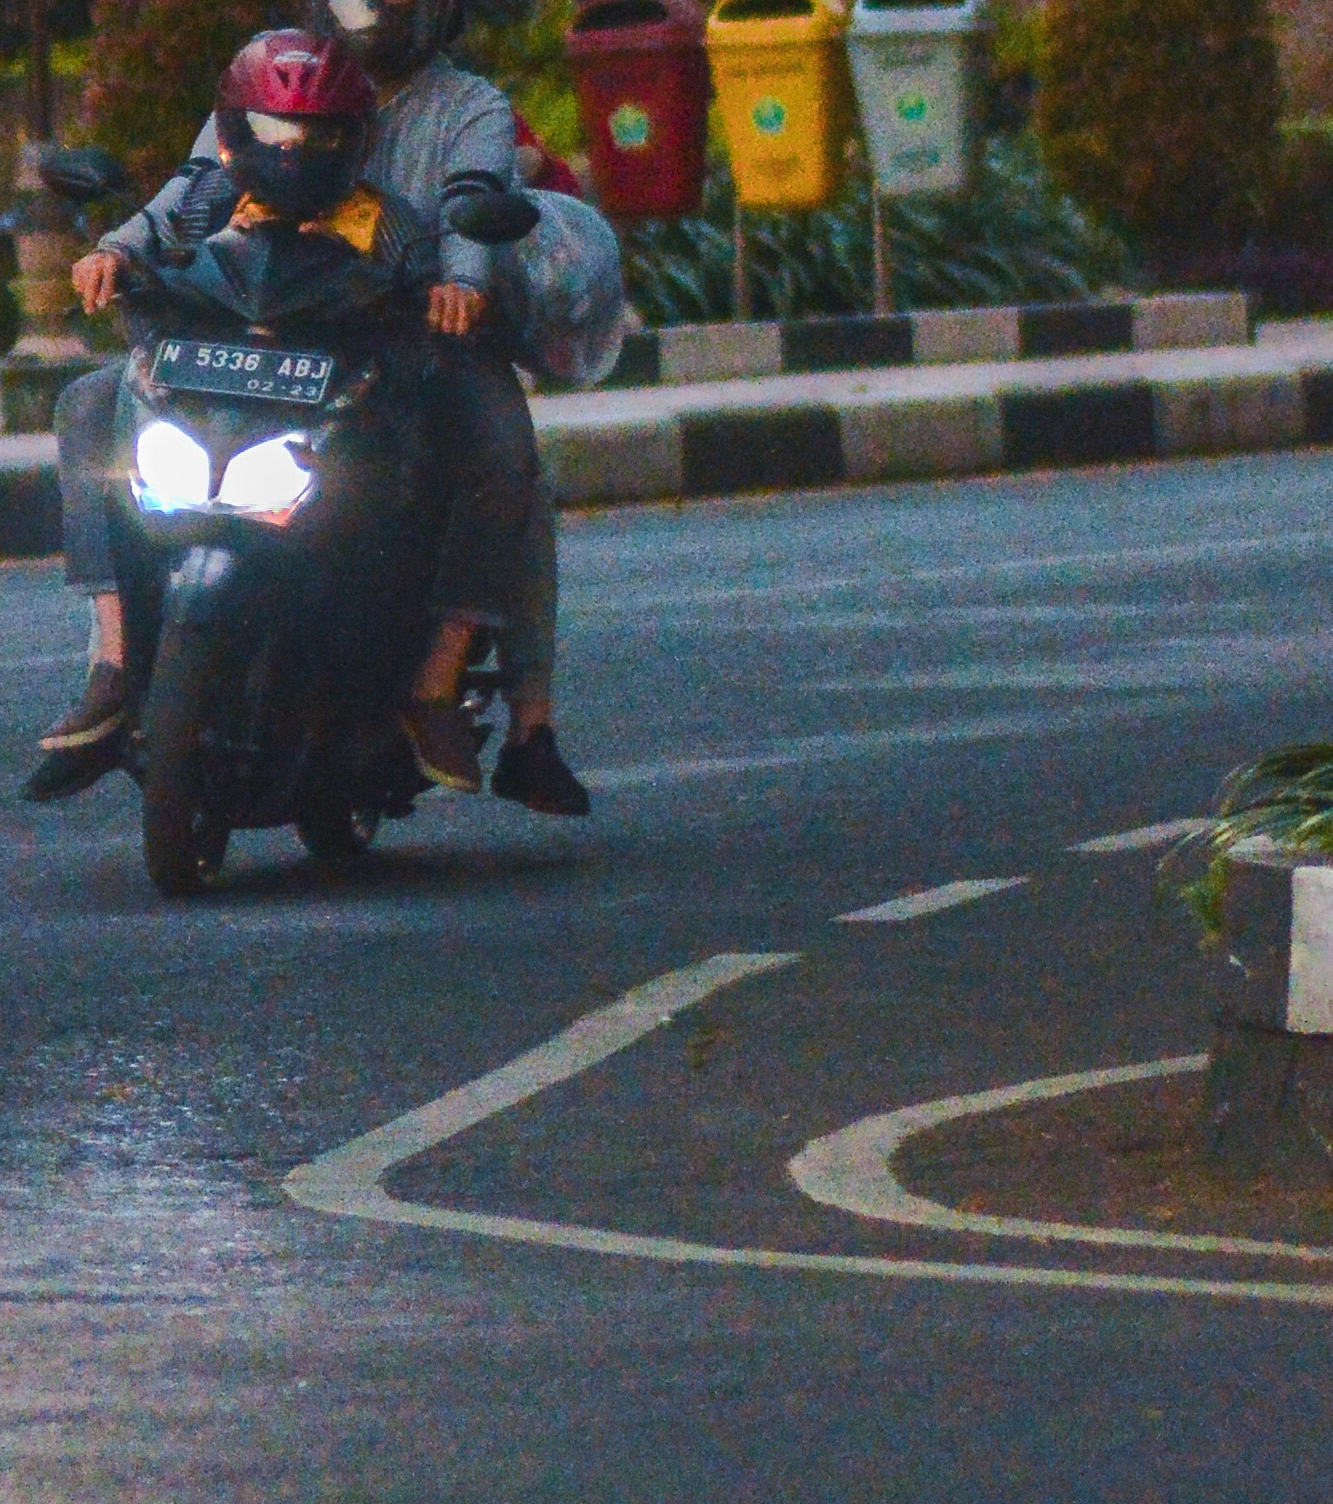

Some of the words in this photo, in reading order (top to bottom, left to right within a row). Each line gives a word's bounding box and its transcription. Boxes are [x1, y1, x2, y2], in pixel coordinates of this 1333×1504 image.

[163, 344, 181, 362] N
[196, 347, 261, 372] 5336
[277, 357, 327, 379] ABJ
